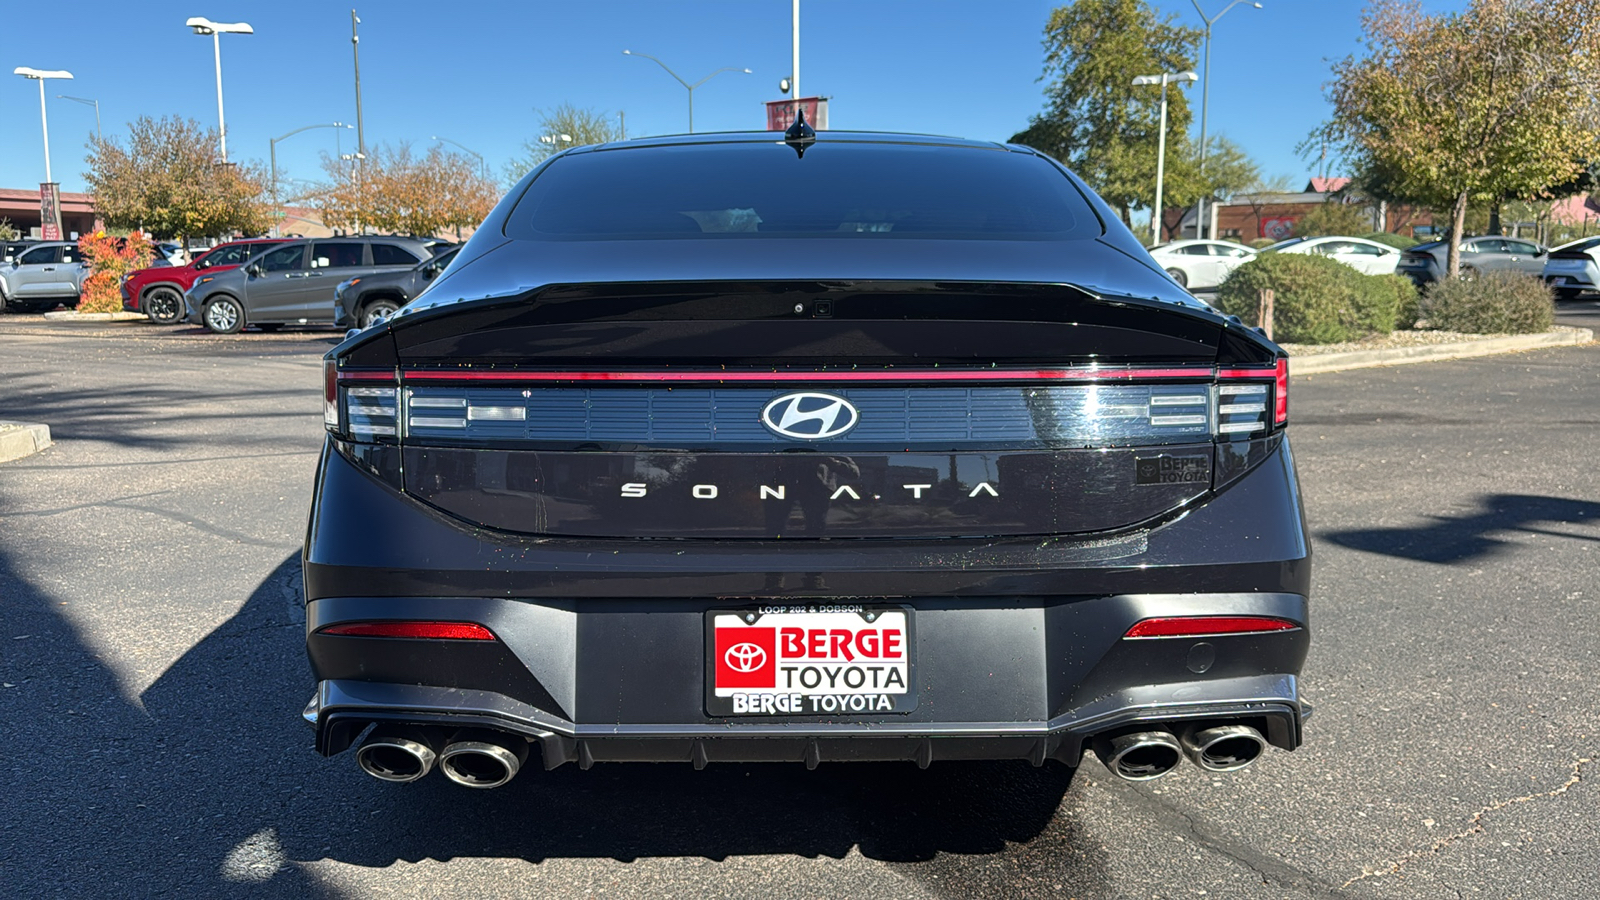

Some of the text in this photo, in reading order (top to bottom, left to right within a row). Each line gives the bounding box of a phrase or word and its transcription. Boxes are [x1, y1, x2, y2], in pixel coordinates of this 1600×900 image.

[1161, 472, 1207, 482] TOYOTA
[621, 482, 999, 500] SONATA
[759, 606, 787, 614] LOOP
[819, 605, 863, 613] DOBSON
[780, 627, 902, 662] BERGE
[780, 666, 905, 689] TOYOTA
[733, 694, 892, 714] BERGE TOYOTA
